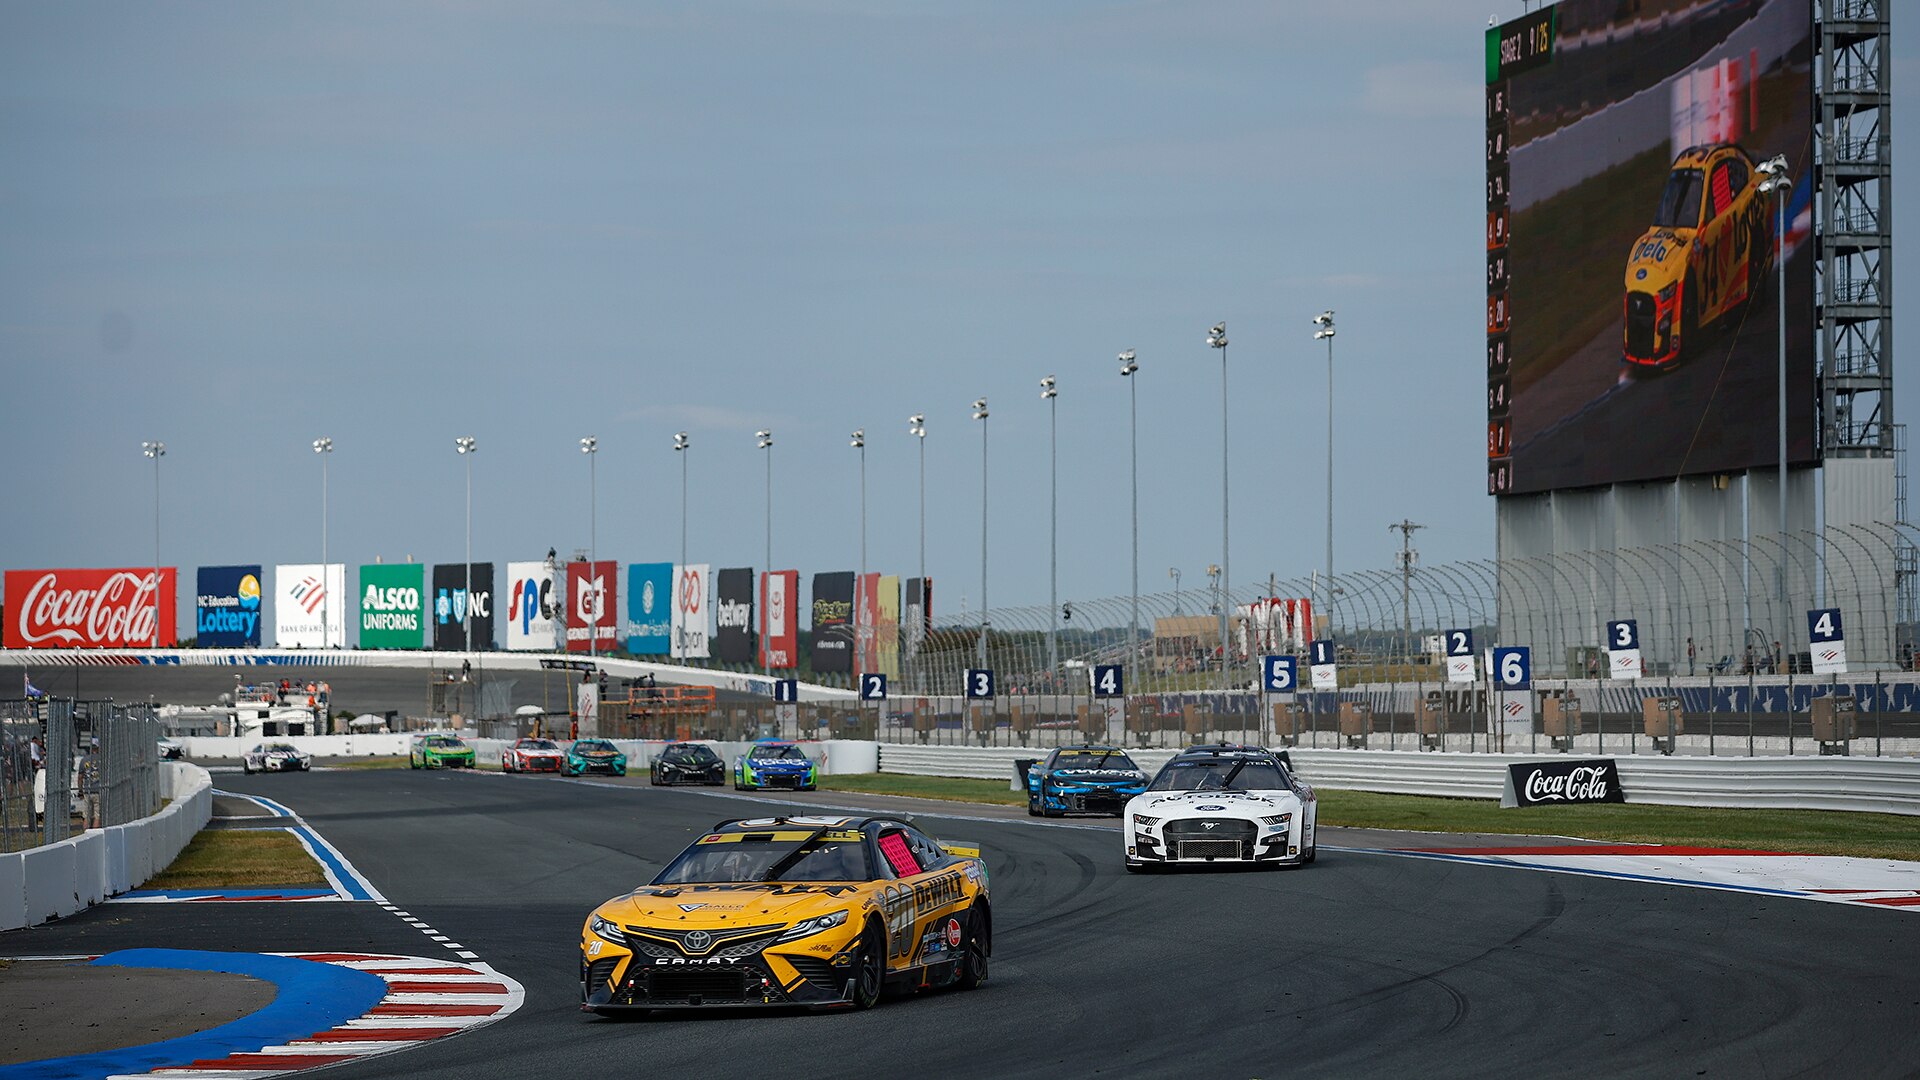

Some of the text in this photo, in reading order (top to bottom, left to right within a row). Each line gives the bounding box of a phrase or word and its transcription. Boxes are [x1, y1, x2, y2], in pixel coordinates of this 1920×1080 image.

[1501, 36, 1516, 65] STAGE
[1517, 33, 1521, 60] 2
[1488, 140, 1492, 160] 2
[1488, 181, 1492, 201] 3
[1488, 218, 1503, 243] 4 9
[1488, 264, 1493, 285] 5
[1488, 305, 1493, 326] 6
[1488, 347, 1493, 368] 7
[1496, 384, 1504, 406] 4
[20, 572, 164, 643] Coca-Cola
[198, 595, 239, 607] NC Education
[363, 584, 418, 610] ALSCO
[469, 591, 490, 617] NC
[198, 607, 256, 638] Lottery
[363, 613, 418, 630] UNIFORMS
[718, 598, 751, 634] betway
[1813, 612, 1835, 637] 4
[1451, 632, 1468, 653] 2
[1615, 622, 1632, 646] 3
[1317, 643, 1325, 662] 1
[1271, 660, 1290, 689] 5
[1501, 652, 1523, 685] 6
[782, 682, 790, 701] 1
[868, 676, 883, 698] 2
[975, 673, 990, 696] 3
[1100, 671, 1117, 694] 4
[1525, 766, 1608, 801] Coca-Cola
[588, 940, 604, 956] 20
[655, 957, 741, 965] CAMRY
